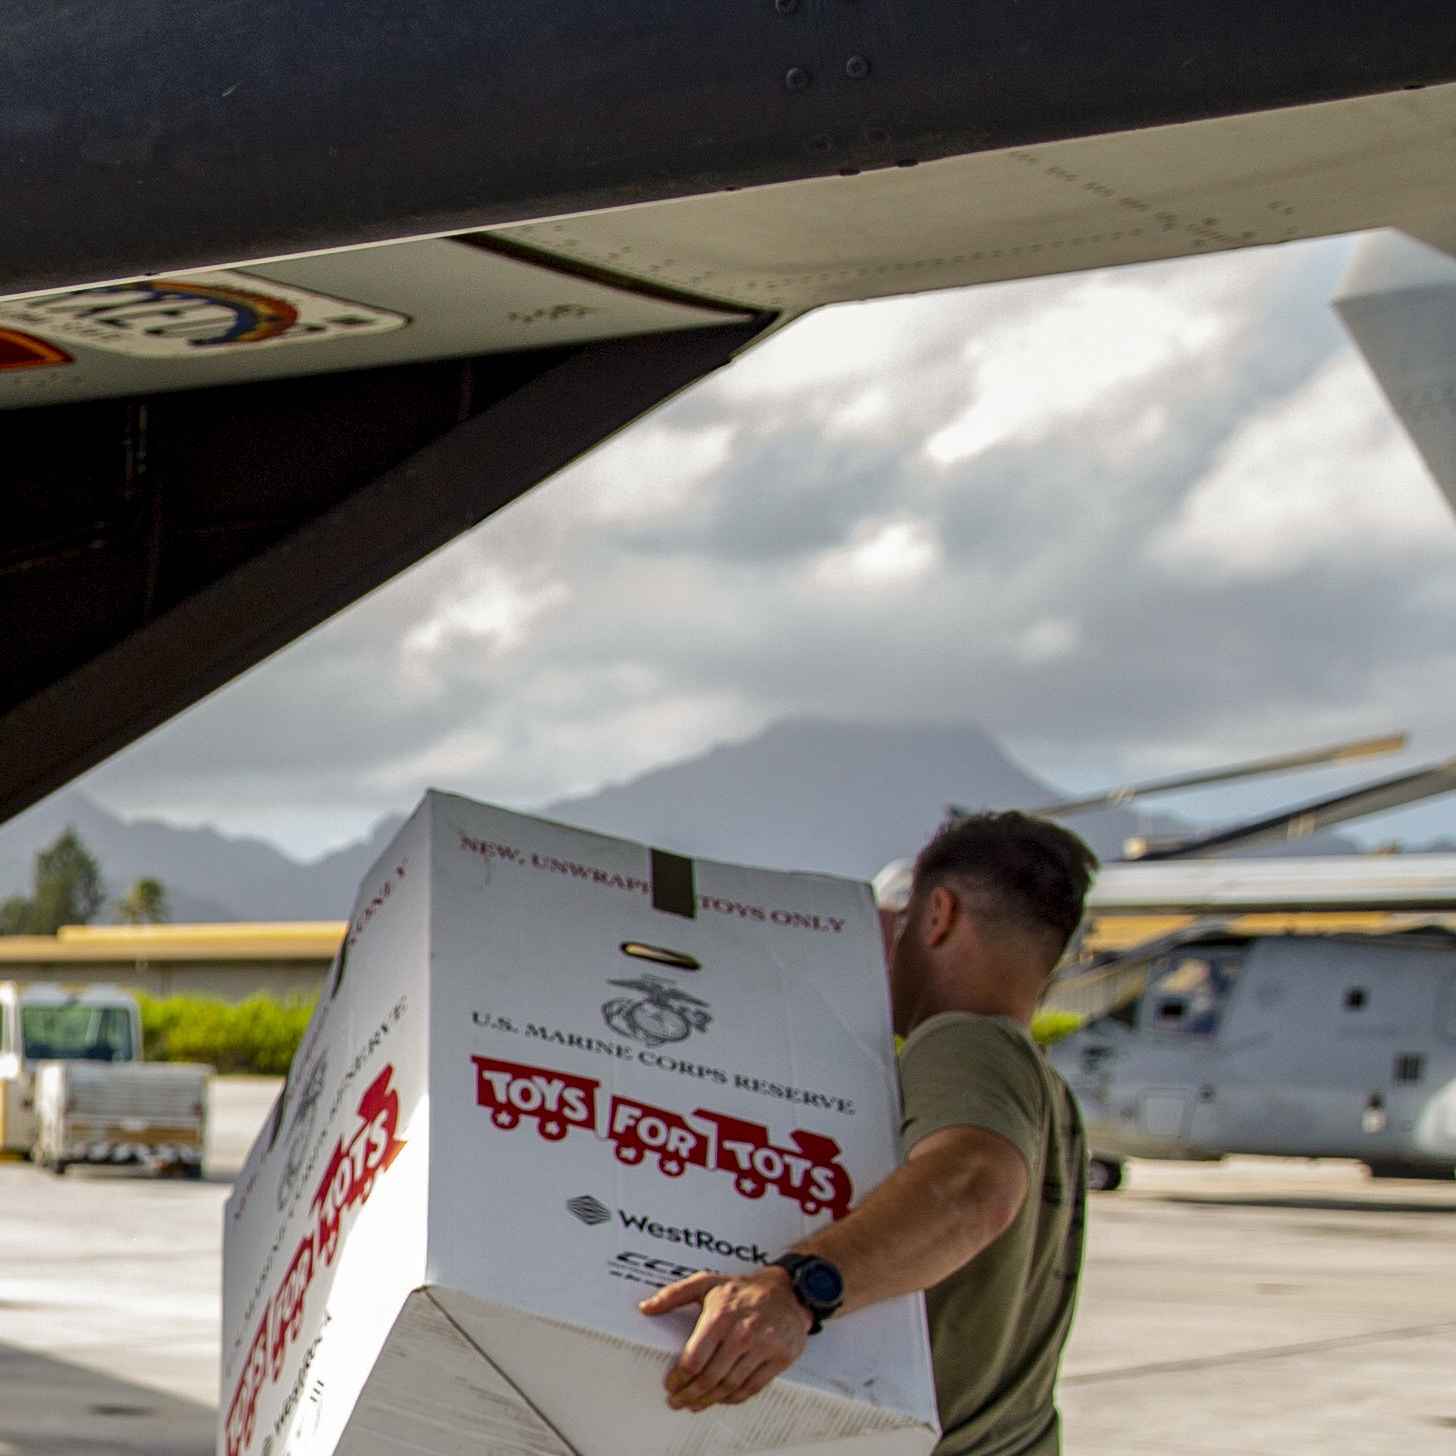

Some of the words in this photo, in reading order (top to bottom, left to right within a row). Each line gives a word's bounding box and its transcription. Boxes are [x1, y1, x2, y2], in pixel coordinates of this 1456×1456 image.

[530, 852, 651, 895] UNWRAP
[697, 893, 767, 923] TOYS
[770, 908, 848, 934] ONLY
[472, 1011, 518, 1033] U.S.
[525, 1023, 633, 1061] MARINE
[638, 1050, 728, 1084] CORPS
[733, 1074, 856, 1116] RESERVE
[323, 1108, 388, 1217] TOTS
[483, 1070, 589, 1122] TOYS
[612, 1104, 698, 1158] FOR
[723, 1139, 837, 1201] TOTS
[618, 1209, 769, 1264] WestRock
